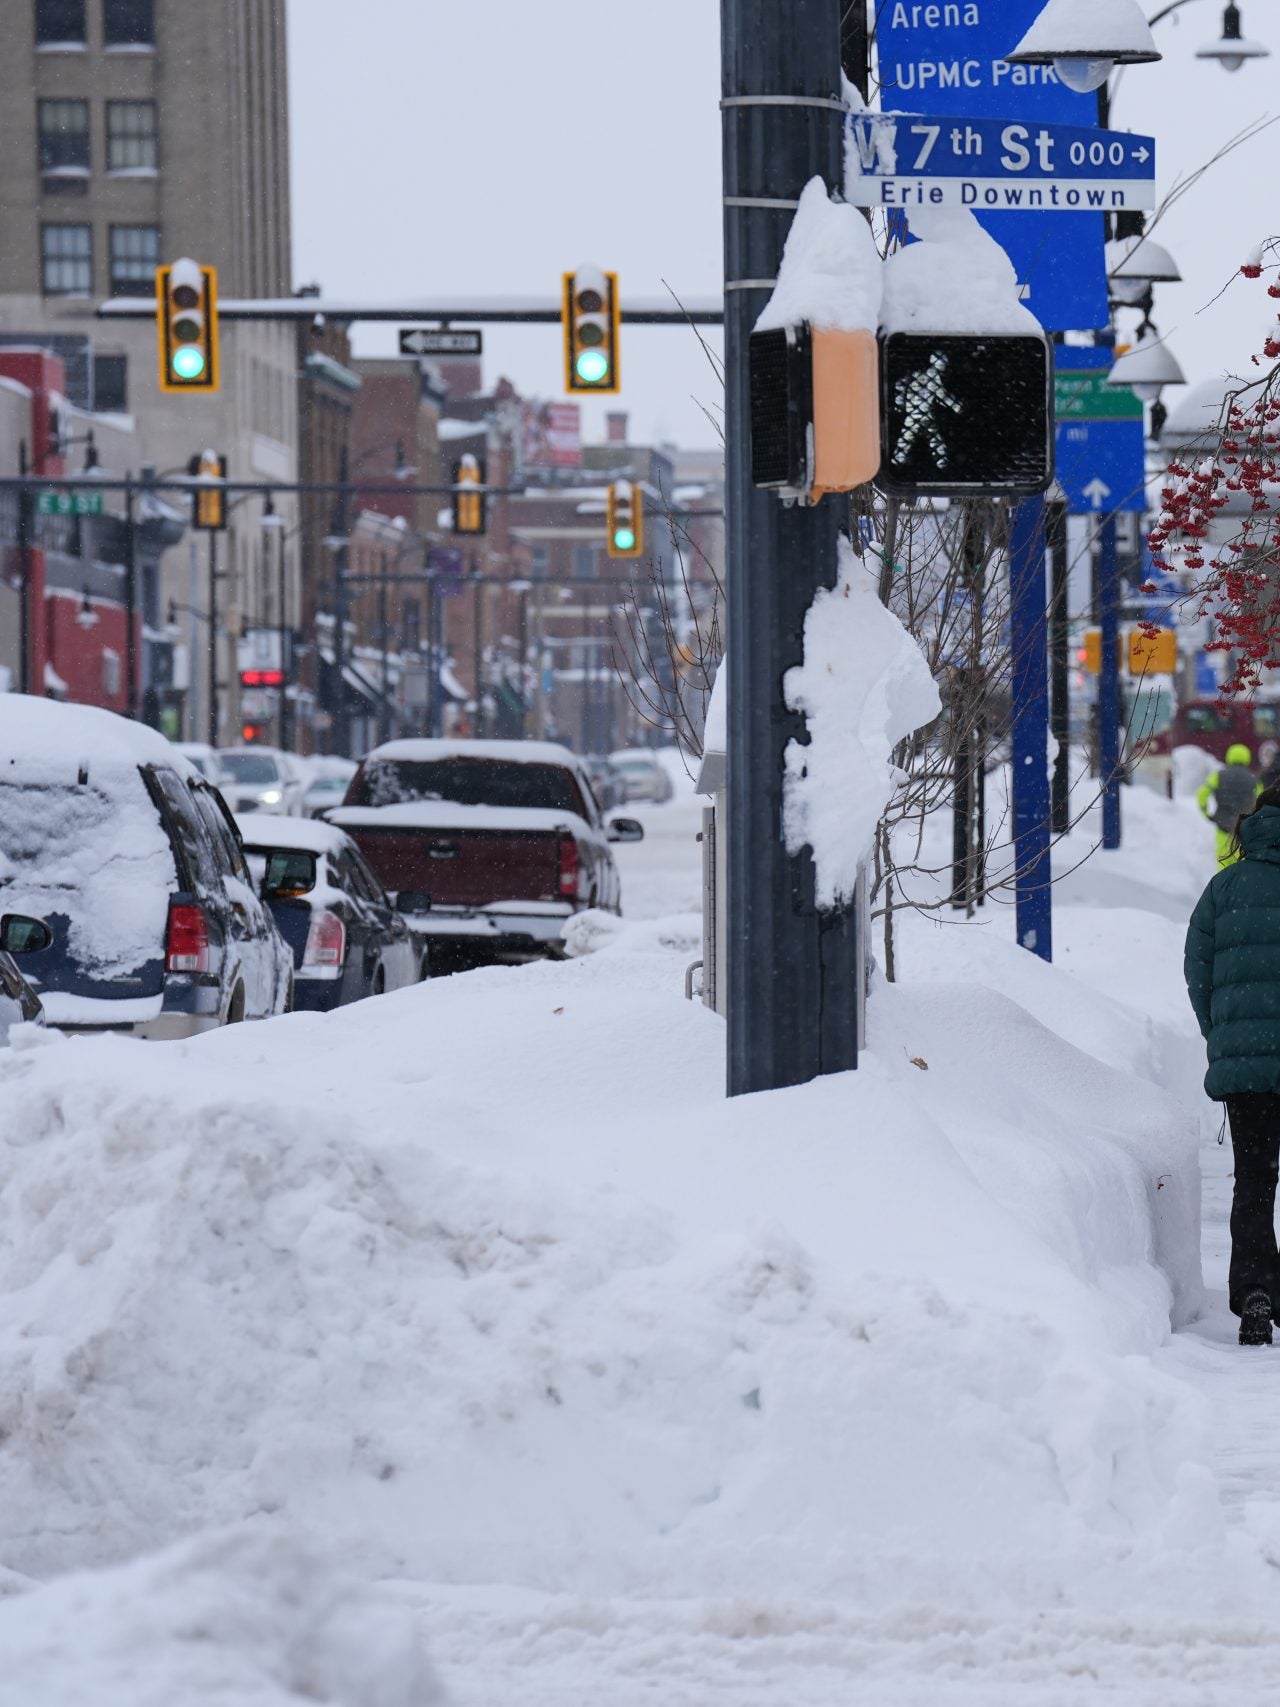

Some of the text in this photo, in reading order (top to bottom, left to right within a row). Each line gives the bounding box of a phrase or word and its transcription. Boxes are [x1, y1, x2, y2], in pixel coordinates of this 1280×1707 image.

[890, 2, 980, 29] Arena
[896, 59, 1059, 90] UPMC Park
[1000, 125, 1055, 172] St
[1070, 141, 1125, 166] 000
[881, 181, 1126, 207] Erie Downtown
